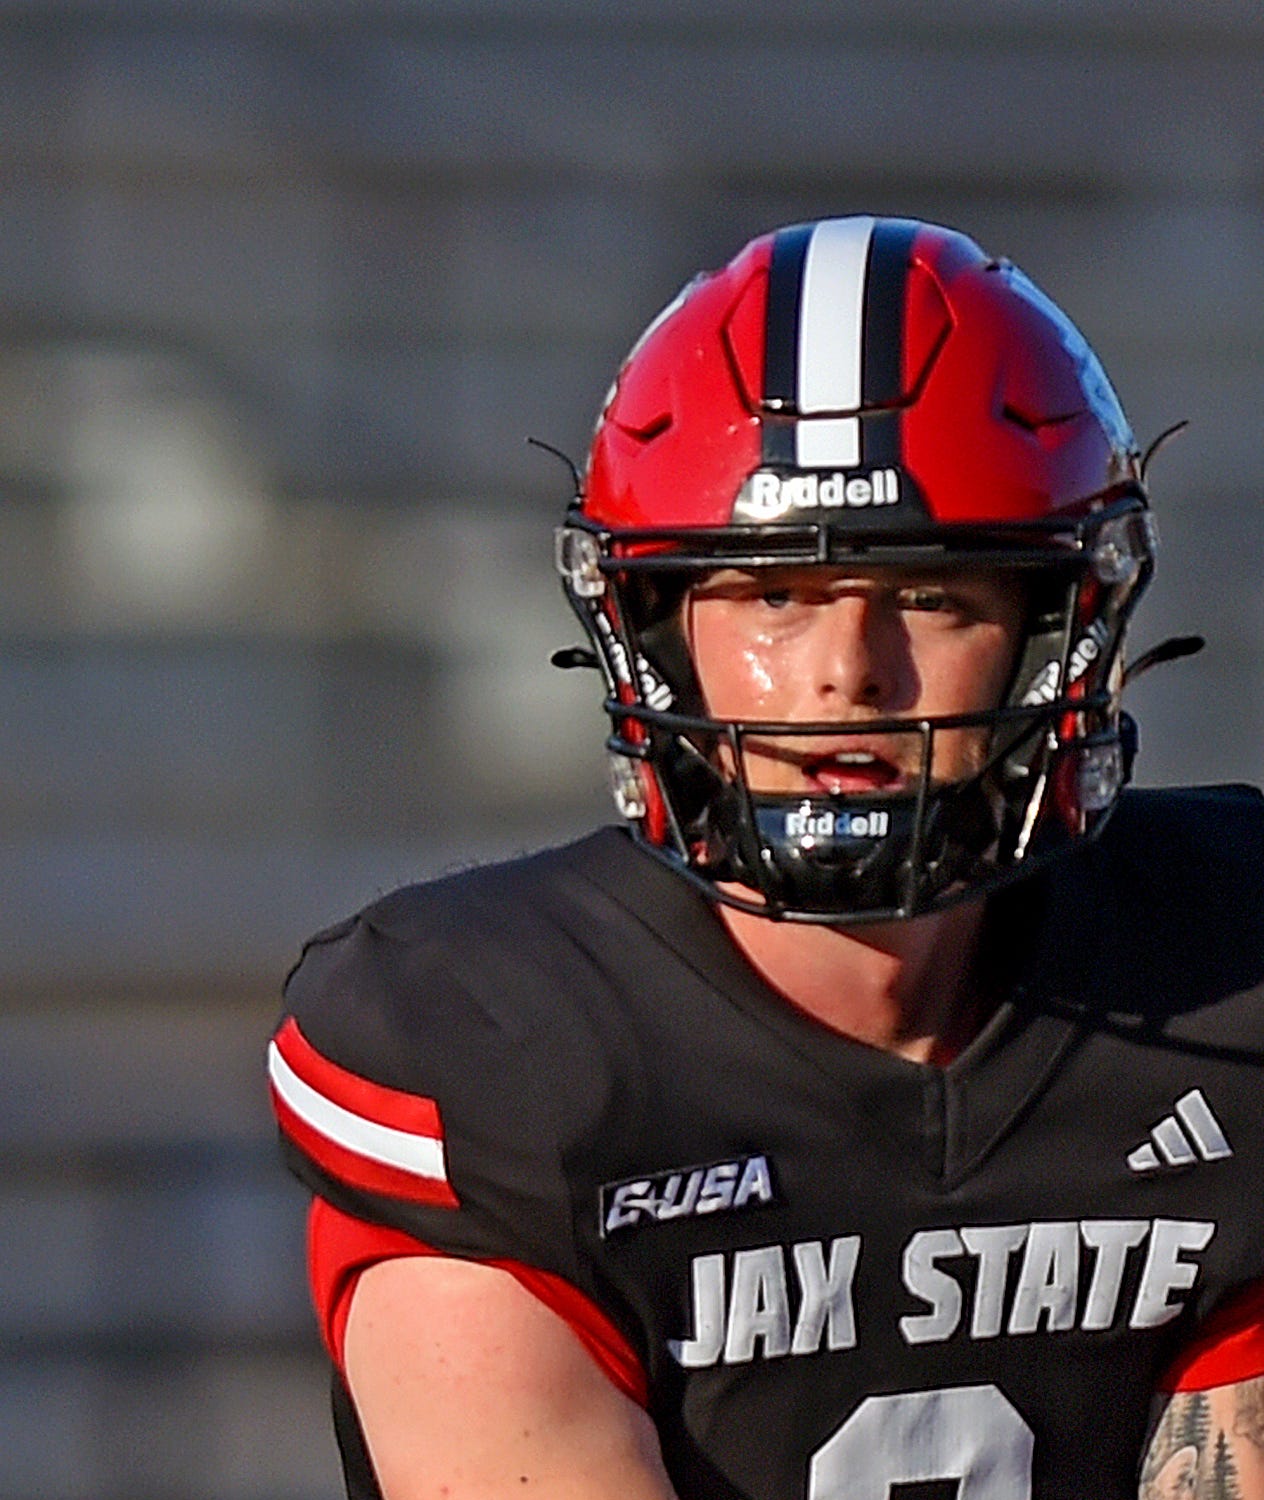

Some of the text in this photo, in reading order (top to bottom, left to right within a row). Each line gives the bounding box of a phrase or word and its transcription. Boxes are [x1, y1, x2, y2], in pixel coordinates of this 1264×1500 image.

[751, 469, 899, 508] Riddell
[668, 1218, 1216, 1368] JAX STATE
